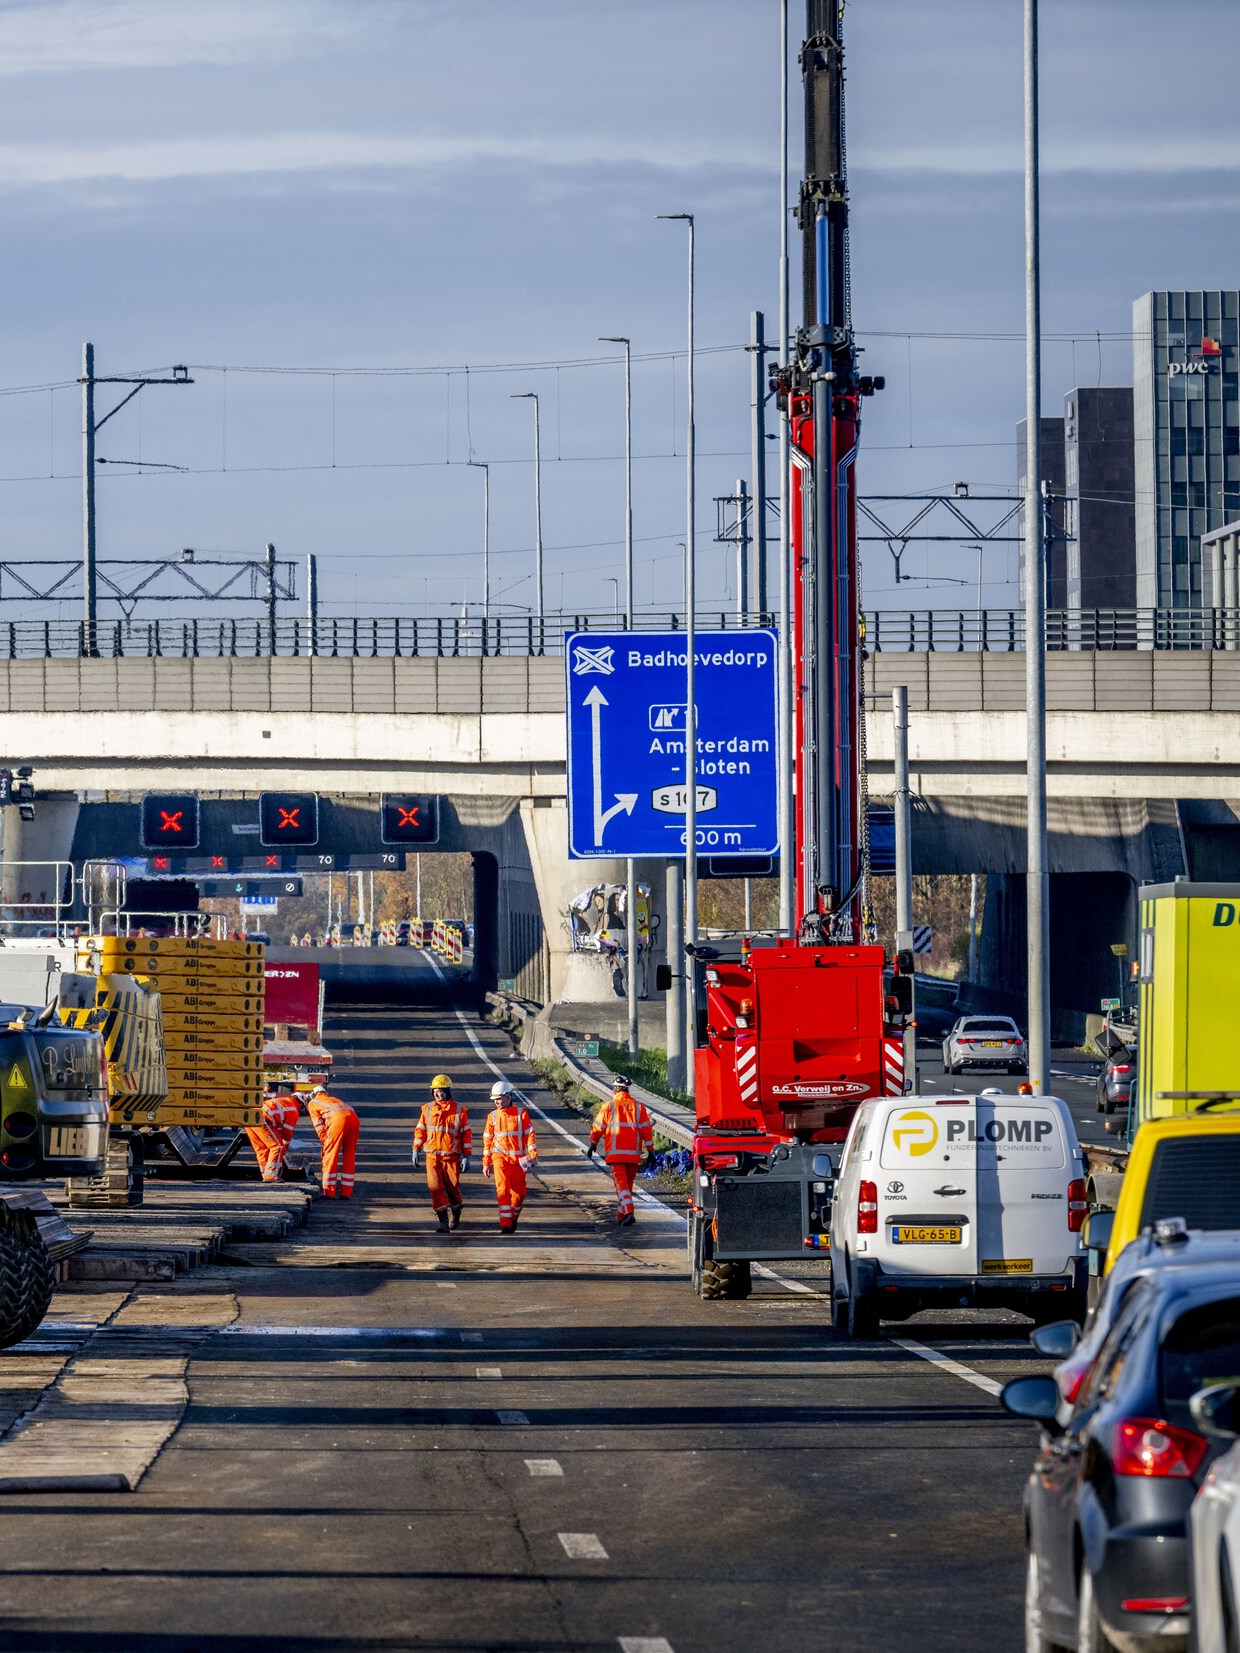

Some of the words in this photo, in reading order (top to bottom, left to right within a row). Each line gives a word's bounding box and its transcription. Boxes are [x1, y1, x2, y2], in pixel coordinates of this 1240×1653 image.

[1168, 361, 1209, 379] pwc
[649, 736, 769, 754] Amterdam
[724, 832, 741, 845] m
[318, 855, 333, 865] 70
[381, 854, 396, 864] 70
[1213, 903, 1240, 926] D
[186, 940, 199, 949] ABI
[184, 959, 199, 968] ABI
[185, 978, 199, 987] ABI
[184, 996, 198, 1006] ABI
[184, 1016, 198, 1025] ABI
[184, 1034, 198, 1043] ABI
[183, 1053, 197, 1062] ABI
[183, 1072, 197, 1080] ABI
[794, 1084, 831, 1094] Verweij
[183, 1090, 197, 1099] ABI
[183, 1109, 197, 1118] ABI
[947, 1120, 1053, 1142] PLOMP
[946, 1144, 1040, 1152] FUNDERINGSTECHNIEKEN
[903, 1229, 957, 1240] VLG-65-B
[982, 1262, 1031, 1271] werkverkeer
